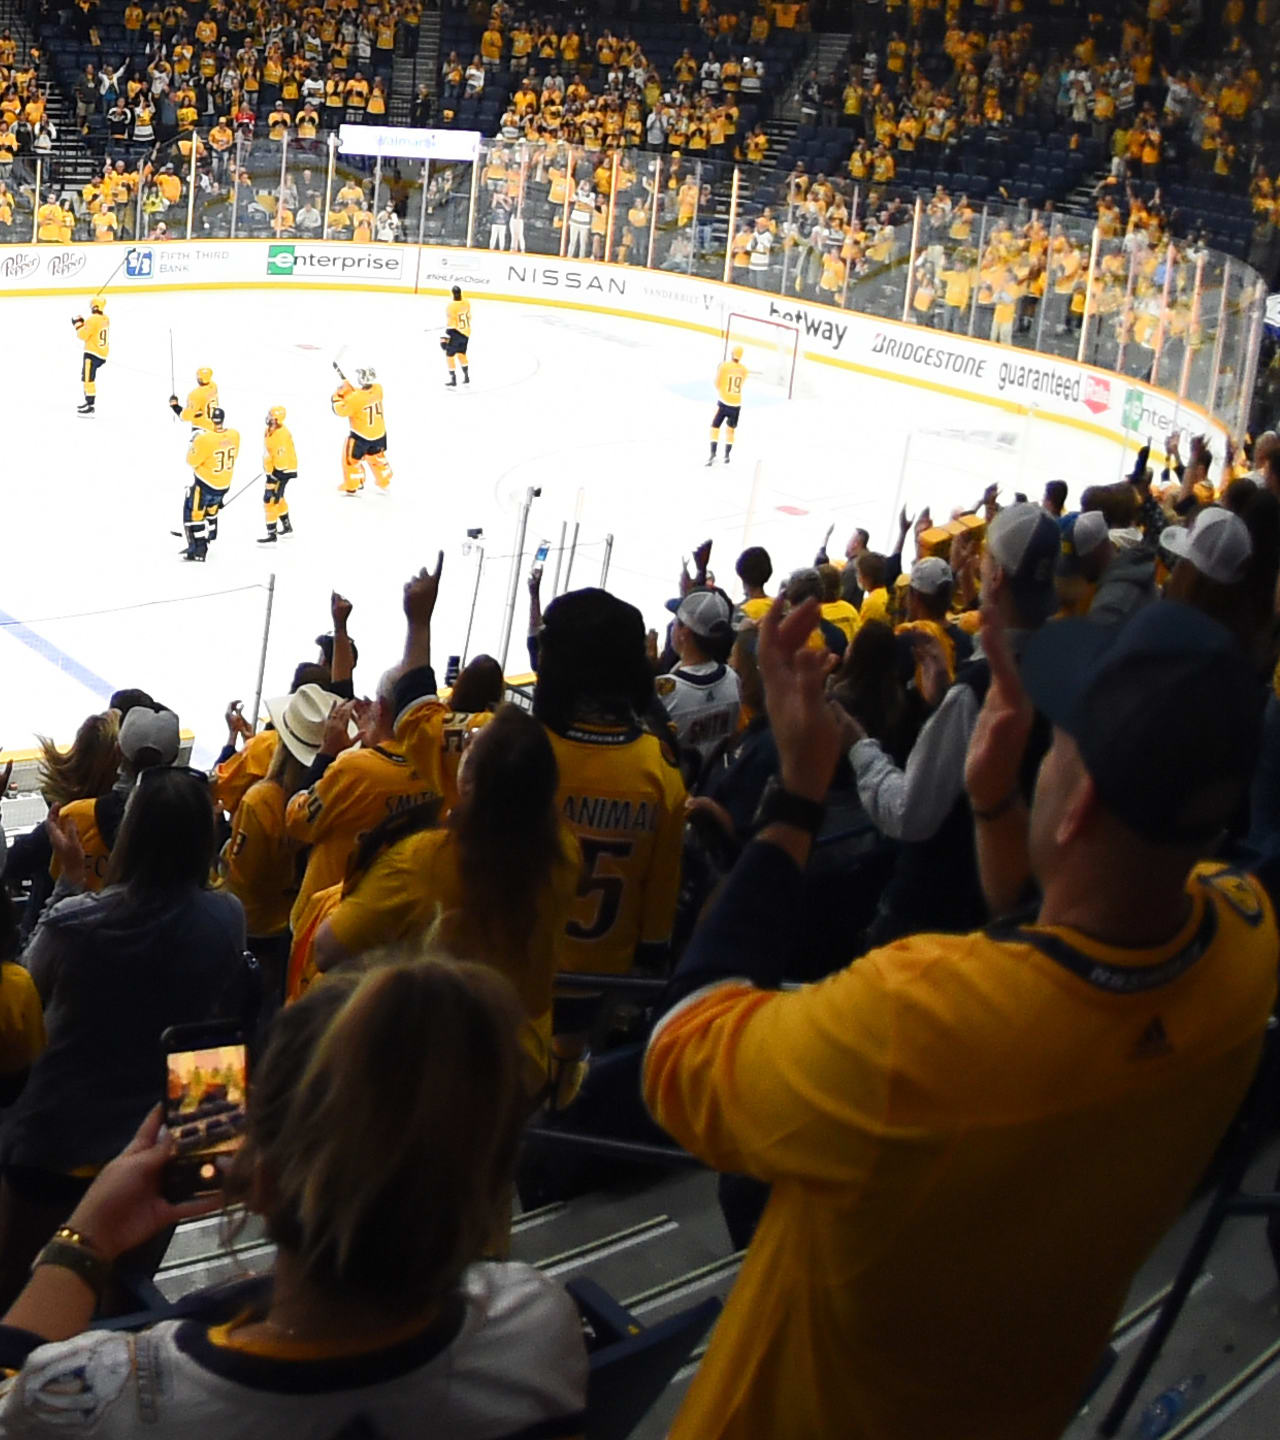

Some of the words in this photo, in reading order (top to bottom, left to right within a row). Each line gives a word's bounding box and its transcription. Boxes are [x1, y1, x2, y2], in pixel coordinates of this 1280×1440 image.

[276, 249, 399, 272] enterprise
[508, 266, 626, 295] NISSAN
[643, 287, 700, 304] VANDERBILT
[871, 333, 987, 378] BRIDGESTONE
[998, 361, 1080, 403] guaranteed
[363, 403, 385, 426] 74
[213, 447, 236, 473] 35
[564, 836, 634, 942] 5
